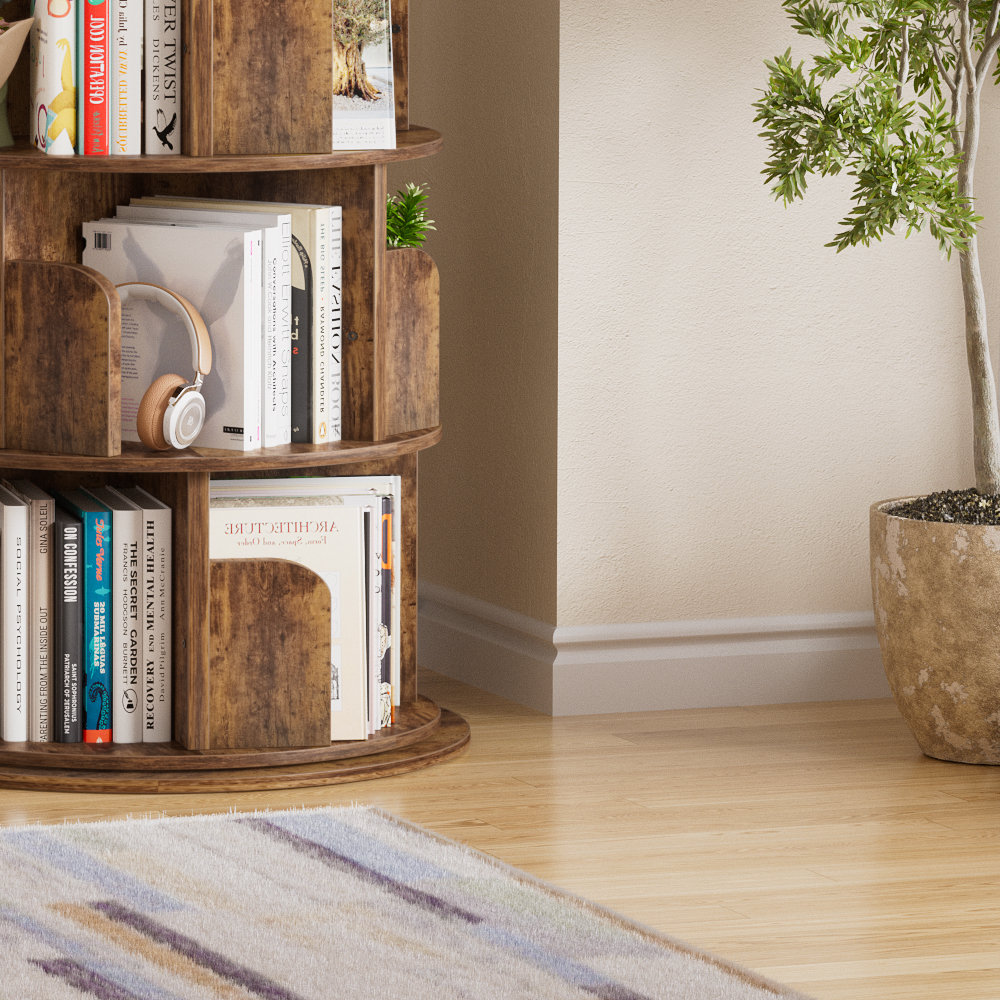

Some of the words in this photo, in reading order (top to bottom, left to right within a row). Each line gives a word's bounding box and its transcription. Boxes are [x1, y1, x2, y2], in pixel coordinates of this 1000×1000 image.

[152, 39, 160, 101] DICKENS
[164, 38, 176, 104] TWIST
[280, 348, 290, 417] Snaps
[40, 504, 48, 532] SOLEIL
[95, 518, 105, 546] Jules
[40, 533, 48, 554] GINA
[64, 527, 78, 542] ON
[146, 520, 154, 573] HEALTH
[95, 548, 105, 581] Verne
[130, 541, 138, 567] THE
[64, 544, 78, 602] CONFESSION
[100, 602, 106, 613] 20
[130, 570, 138, 620] SECRET
[146, 576, 154, 632] MENTAL
[40, 606, 48, 624] OUT
[40, 625, 48, 652] INSIDE
[40, 655, 48, 671] THE
[130, 630, 138, 685] GARDEN
[40, 673, 48, 696] FROM
[64, 688, 70, 697] OF
[146, 659, 154, 730] RECOVERY
